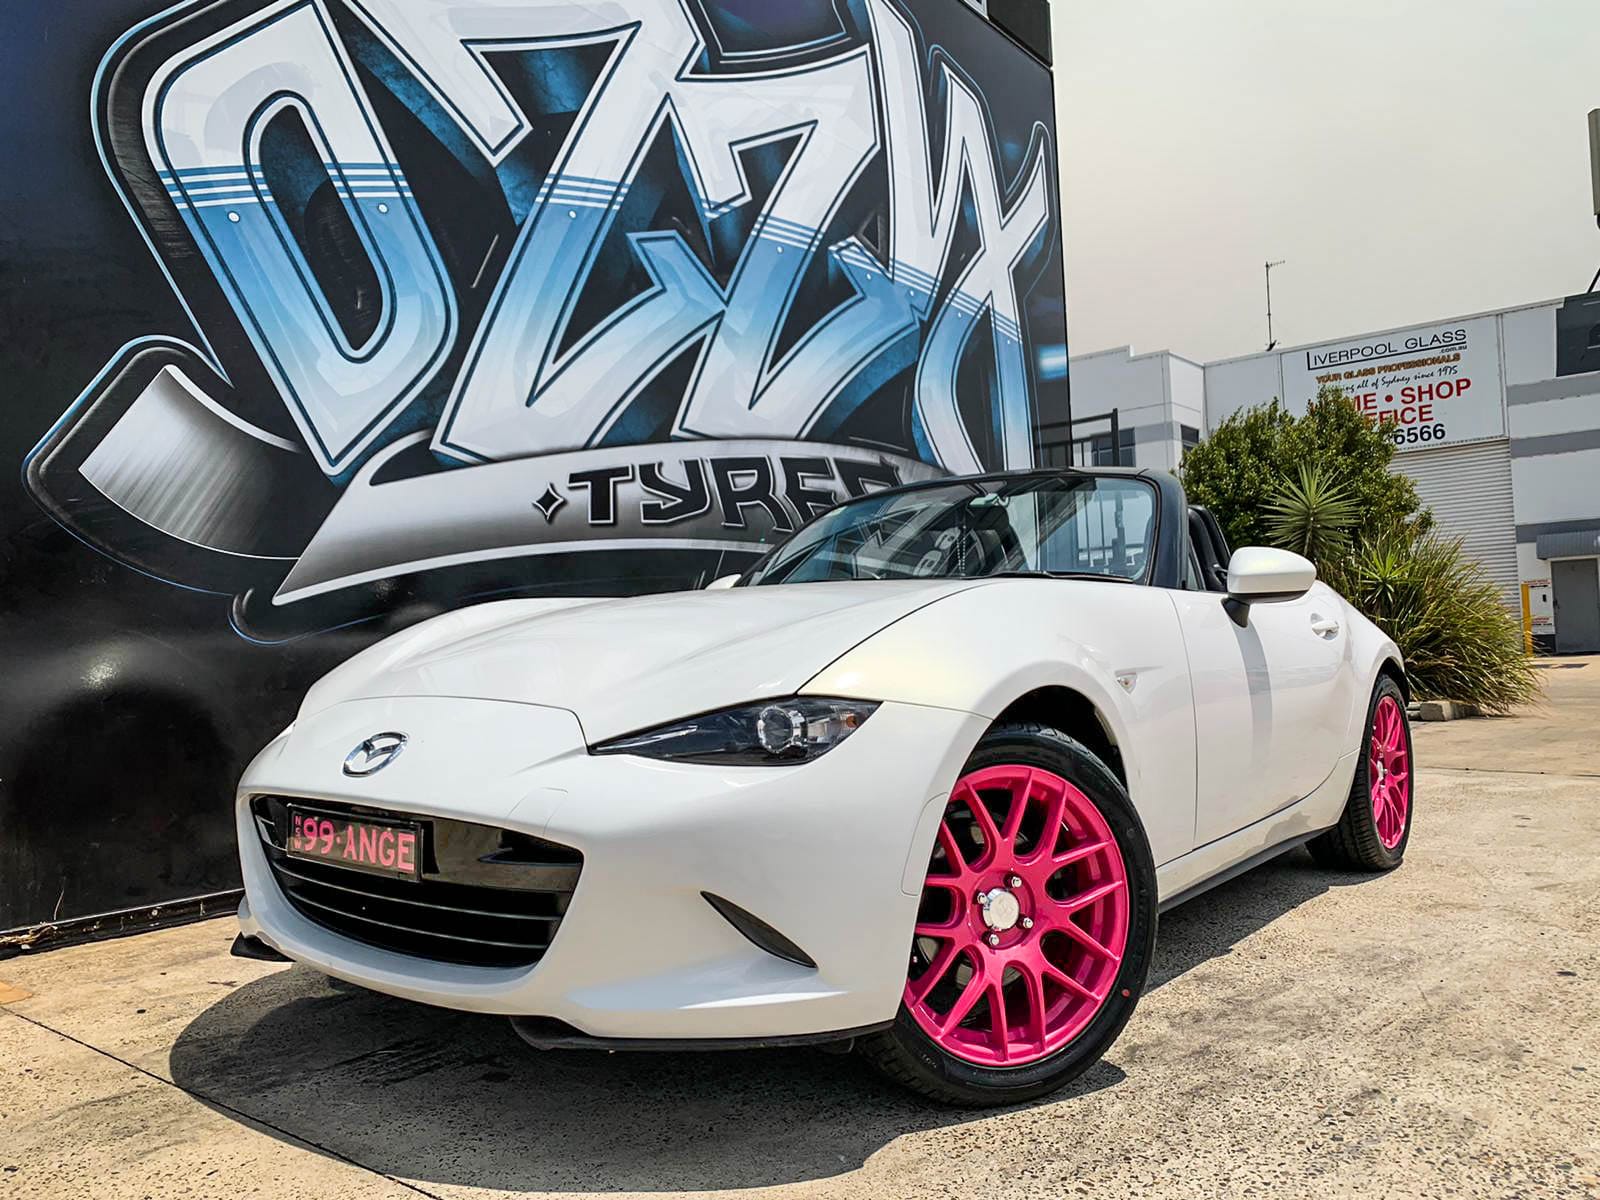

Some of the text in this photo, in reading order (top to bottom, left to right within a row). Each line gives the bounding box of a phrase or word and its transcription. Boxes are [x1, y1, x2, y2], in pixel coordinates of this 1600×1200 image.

[1306, 329, 1467, 370] LIVERPOOL GLASS
[1316, 352, 1461, 384] YOUR GLASS PROFESSIONALS
[1356, 378, 1369, 389] all
[1370, 377, 1380, 389] of
[1381, 373, 1411, 387] Sydney
[1414, 371, 1434, 381] since
[1437, 365, 1458, 377] 1975
[1400, 377, 1472, 405] SHOP
